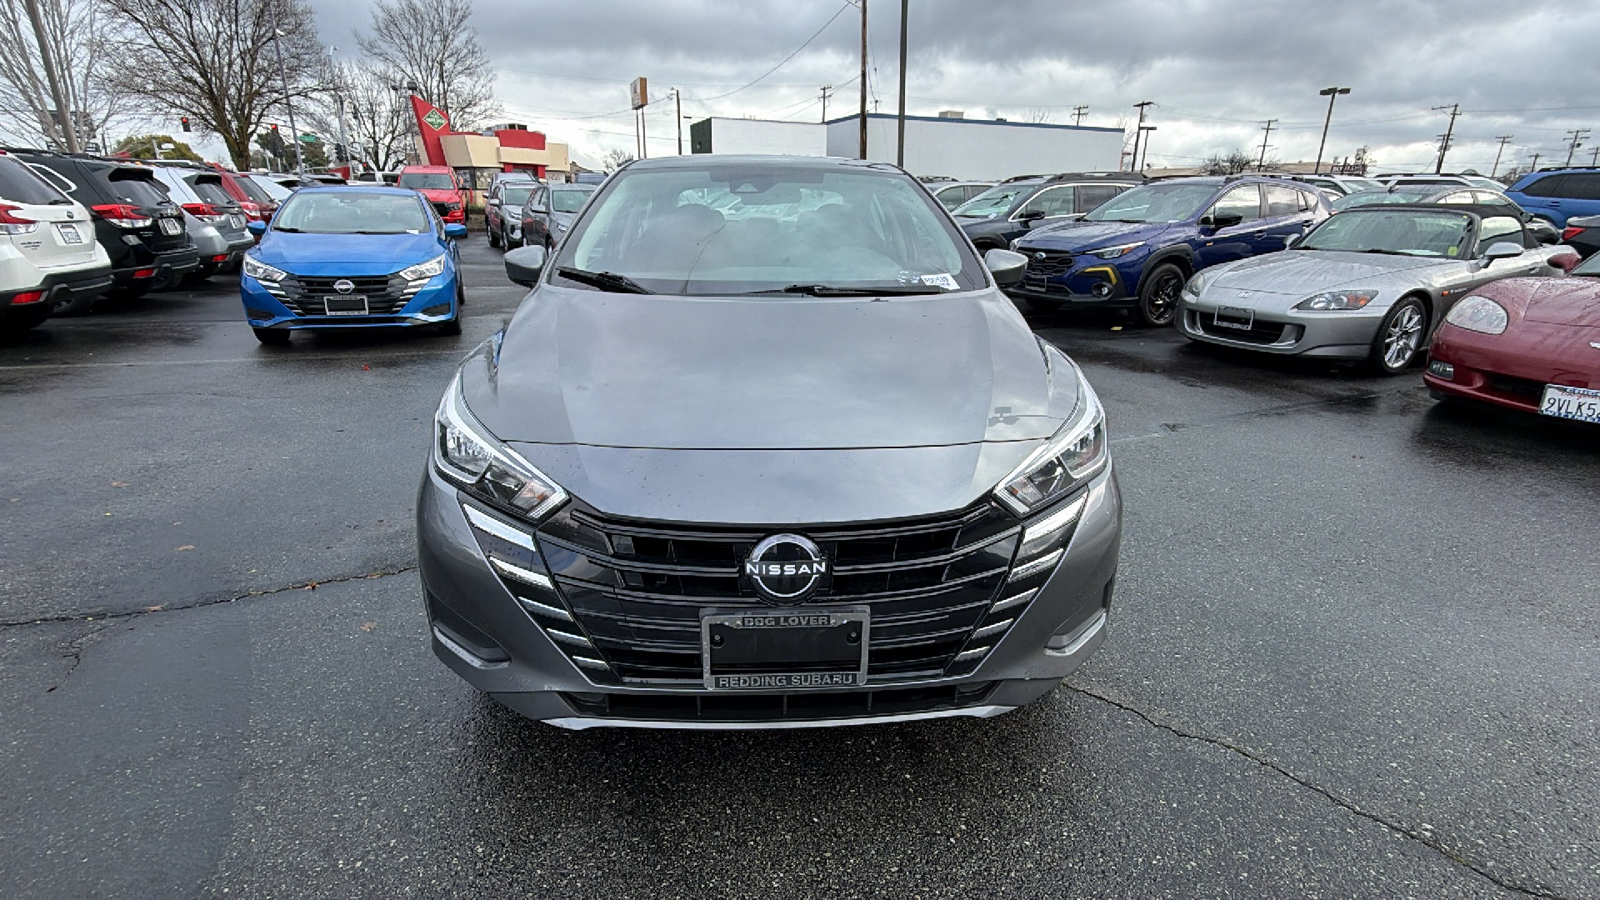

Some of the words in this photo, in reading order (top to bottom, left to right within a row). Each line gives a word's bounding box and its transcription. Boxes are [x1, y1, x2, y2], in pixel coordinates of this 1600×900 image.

[746, 561, 826, 575] NISSAN
[744, 616, 776, 627] DOG
[779, 615, 829, 627] LOVER
[719, 676, 788, 688] REDDING
[791, 674, 853, 687] SUBARU
